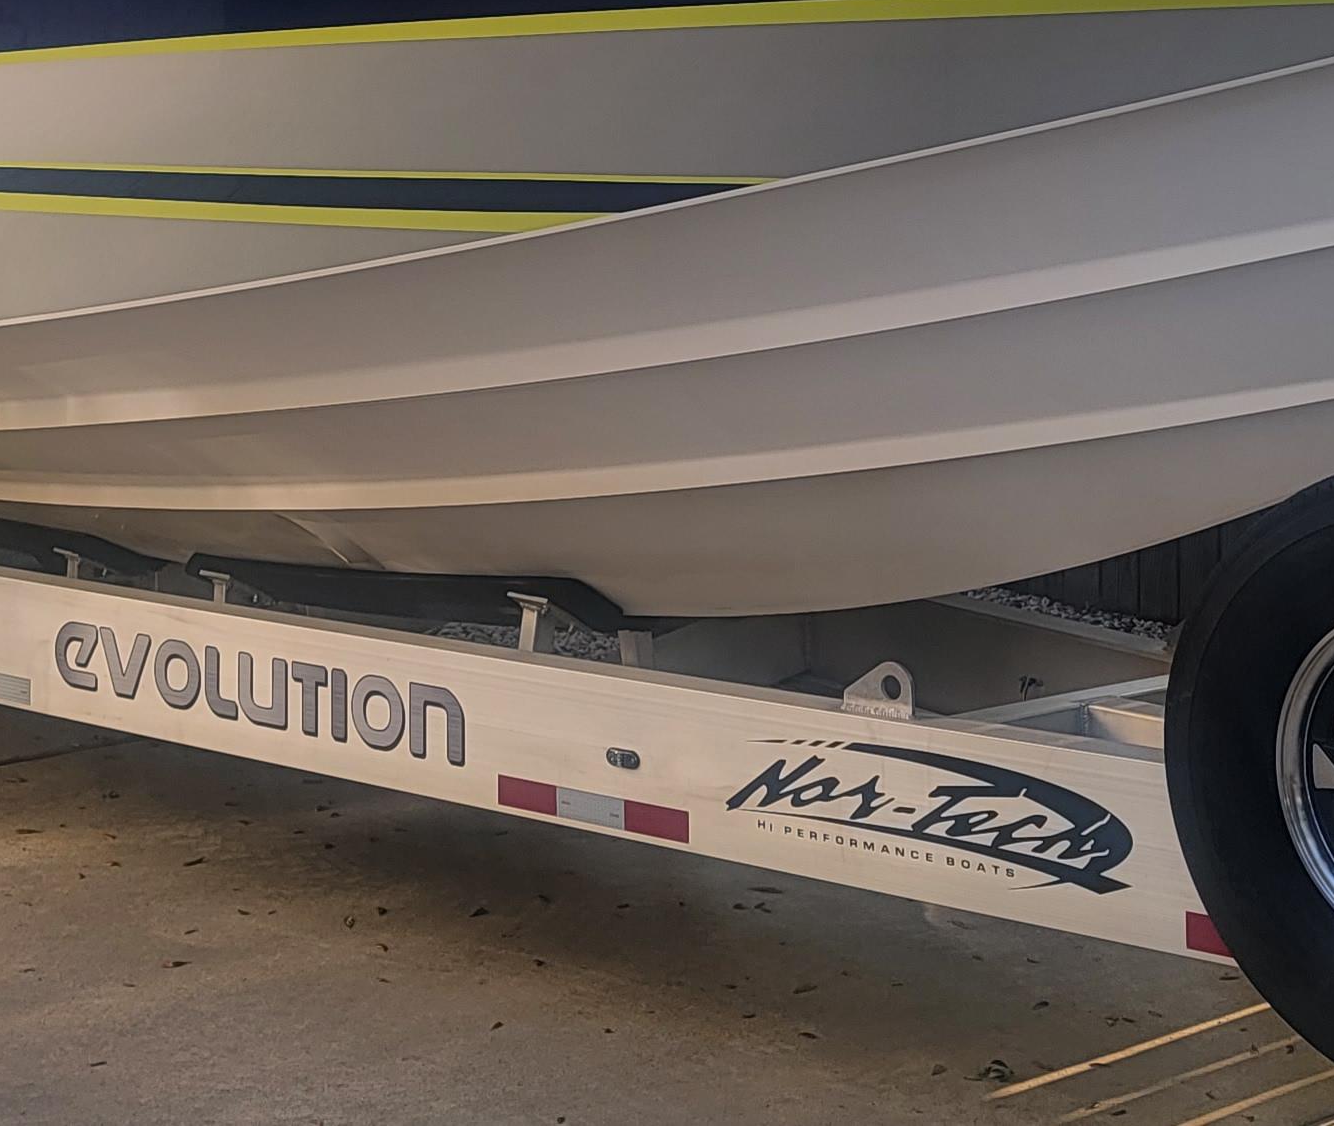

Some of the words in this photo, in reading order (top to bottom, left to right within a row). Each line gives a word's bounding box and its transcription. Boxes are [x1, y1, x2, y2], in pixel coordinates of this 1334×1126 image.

[725, 754, 1115, 871] Nor-Tech
[757, 819, 774, 833] HI
[783, 826, 934, 862] PERFORMANCE
[946, 857, 1016, 878] BOATS
